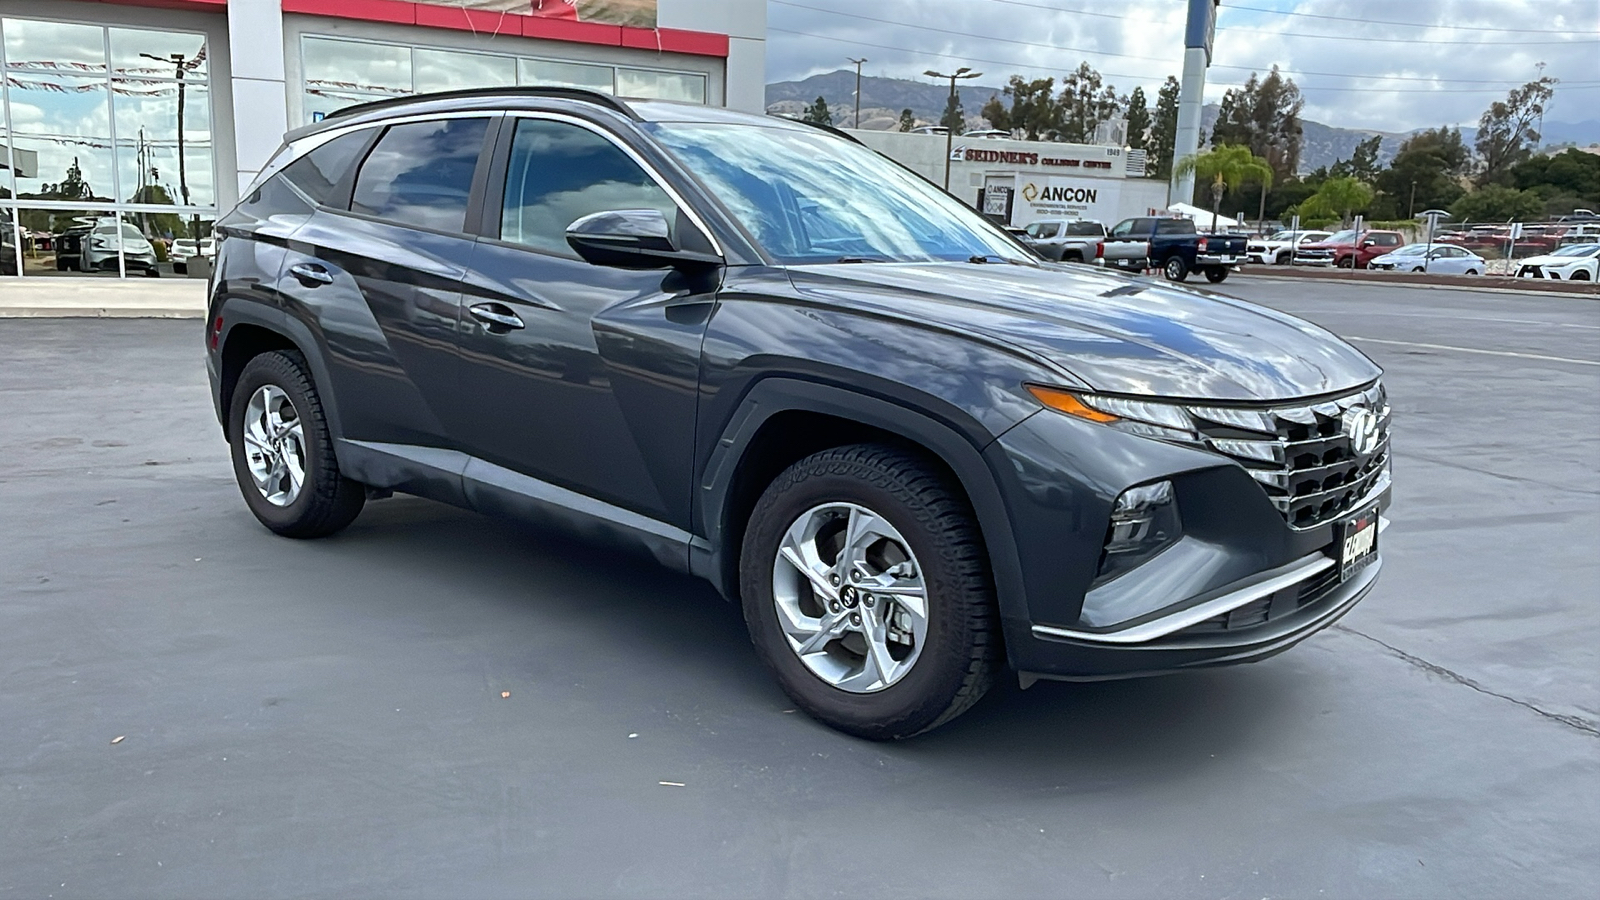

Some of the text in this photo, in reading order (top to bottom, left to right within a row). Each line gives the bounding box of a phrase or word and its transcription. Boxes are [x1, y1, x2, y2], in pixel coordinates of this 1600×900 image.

[965, 149, 1039, 165] SEIDNER'S
[992, 185, 1010, 193] ANCO
[1040, 186, 1098, 204] ANCON
